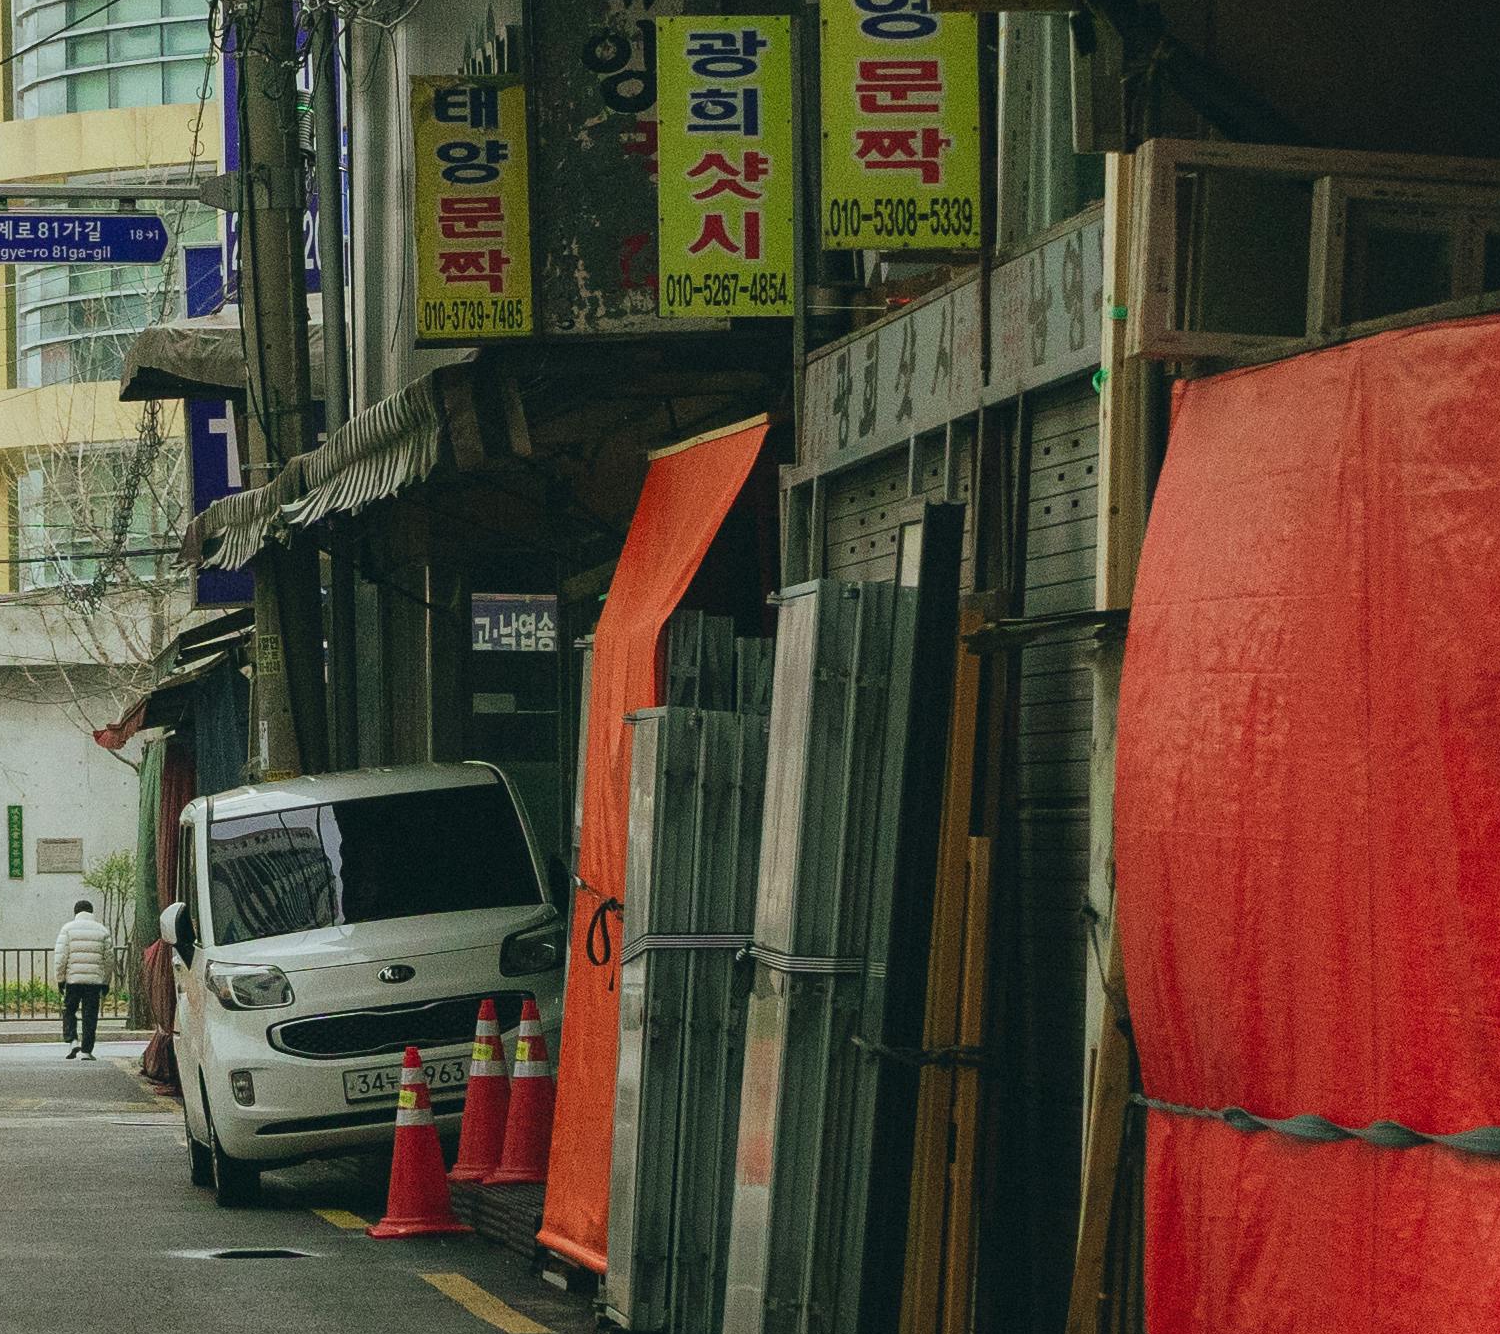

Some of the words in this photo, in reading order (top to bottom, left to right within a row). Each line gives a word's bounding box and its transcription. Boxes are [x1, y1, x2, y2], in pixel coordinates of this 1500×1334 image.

[686, 29, 768, 137] 광희
[434, 85, 510, 185] 태양
[854, 59, 951, 185] 문짝
[686, 151, 770, 261] 샷시
[829, 197, 973, 236] 010-5308-5339
[51, 244, 112, 260] 81ga-gil
[438, 195, 511, 294] 문짝
[424, 298, 523, 333] 010-3739-7485
[666, 271, 788, 308] 010-5267-4854
[424, 1061, 465, 1084] 963
